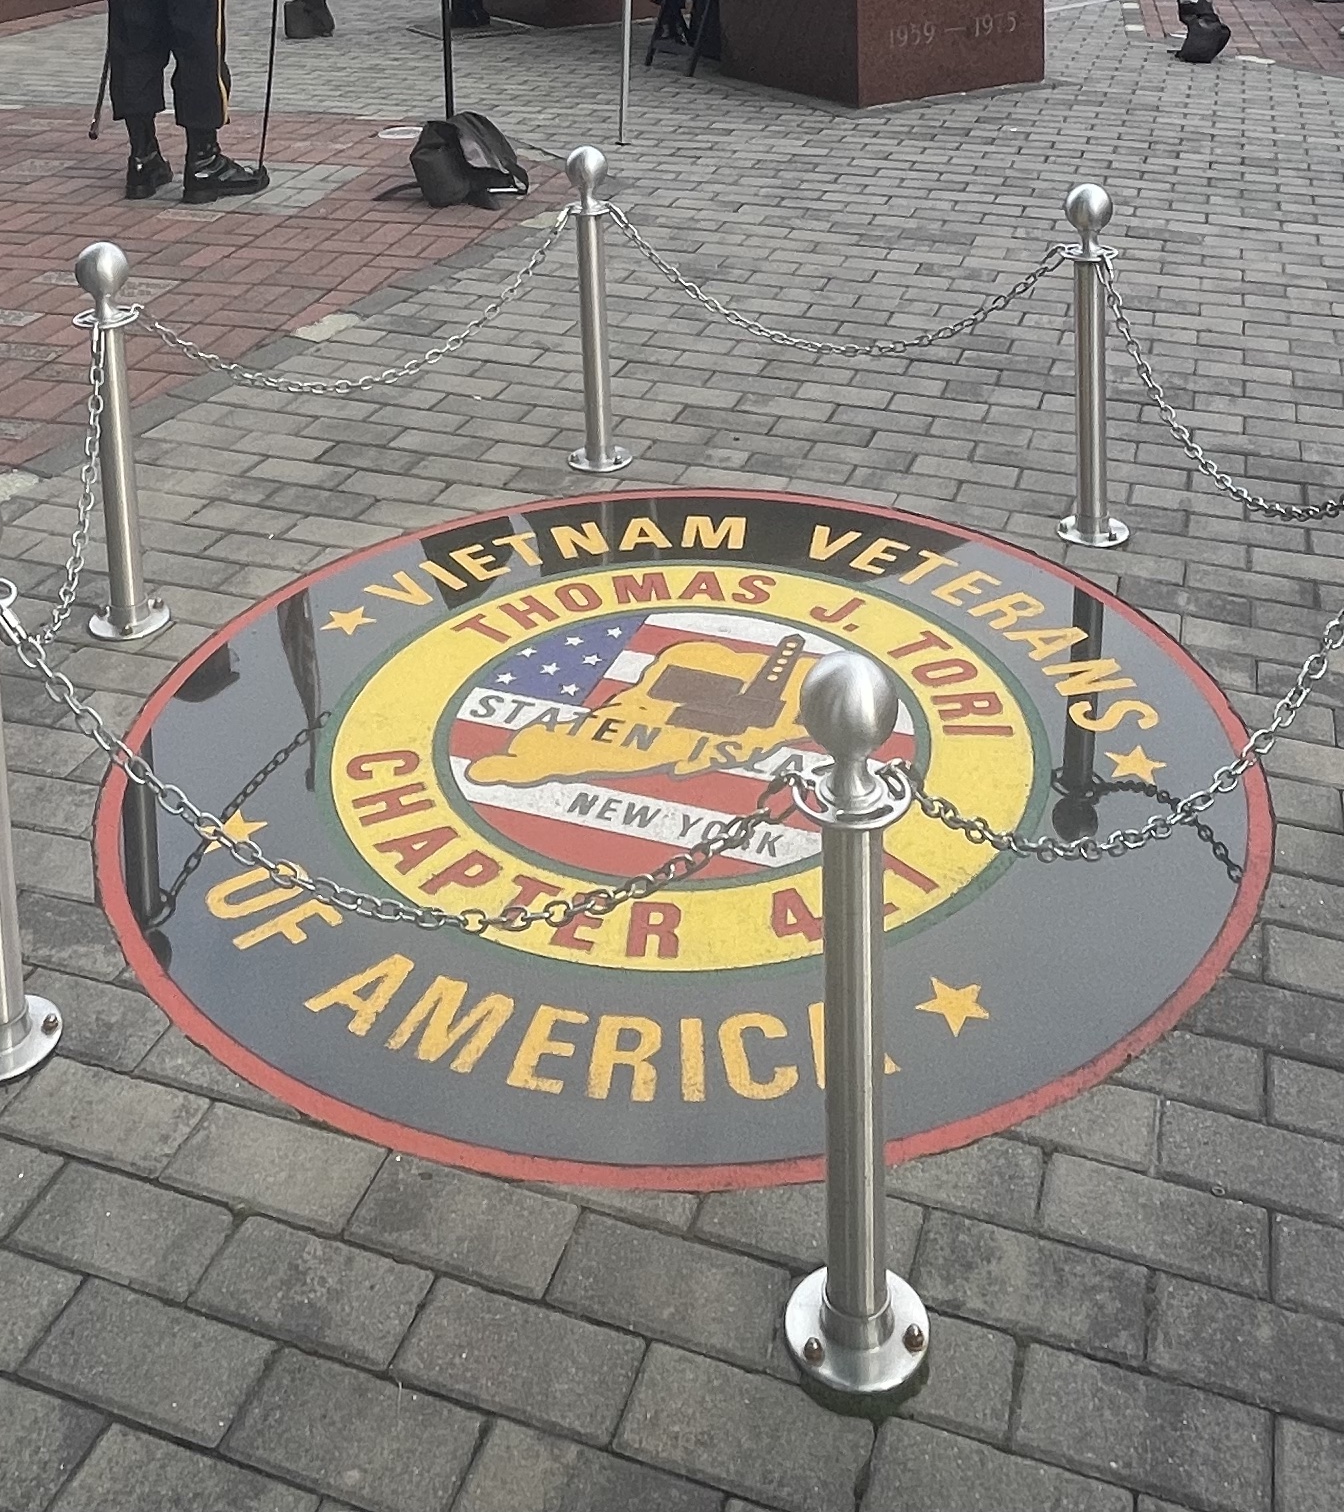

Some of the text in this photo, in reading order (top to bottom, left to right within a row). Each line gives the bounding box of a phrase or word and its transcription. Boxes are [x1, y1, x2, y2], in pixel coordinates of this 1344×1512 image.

[889, 19, 937, 48] 1959
[365, 515, 1159, 732] VIETNAM VETERANS
[454, 571, 1014, 737] THOMAS J. TORI
[470, 694, 663, 751] STATEN
[346, 750, 682, 958] CHAPTER
[567, 792, 662, 829] NEW
[205, 860, 344, 950] OF
